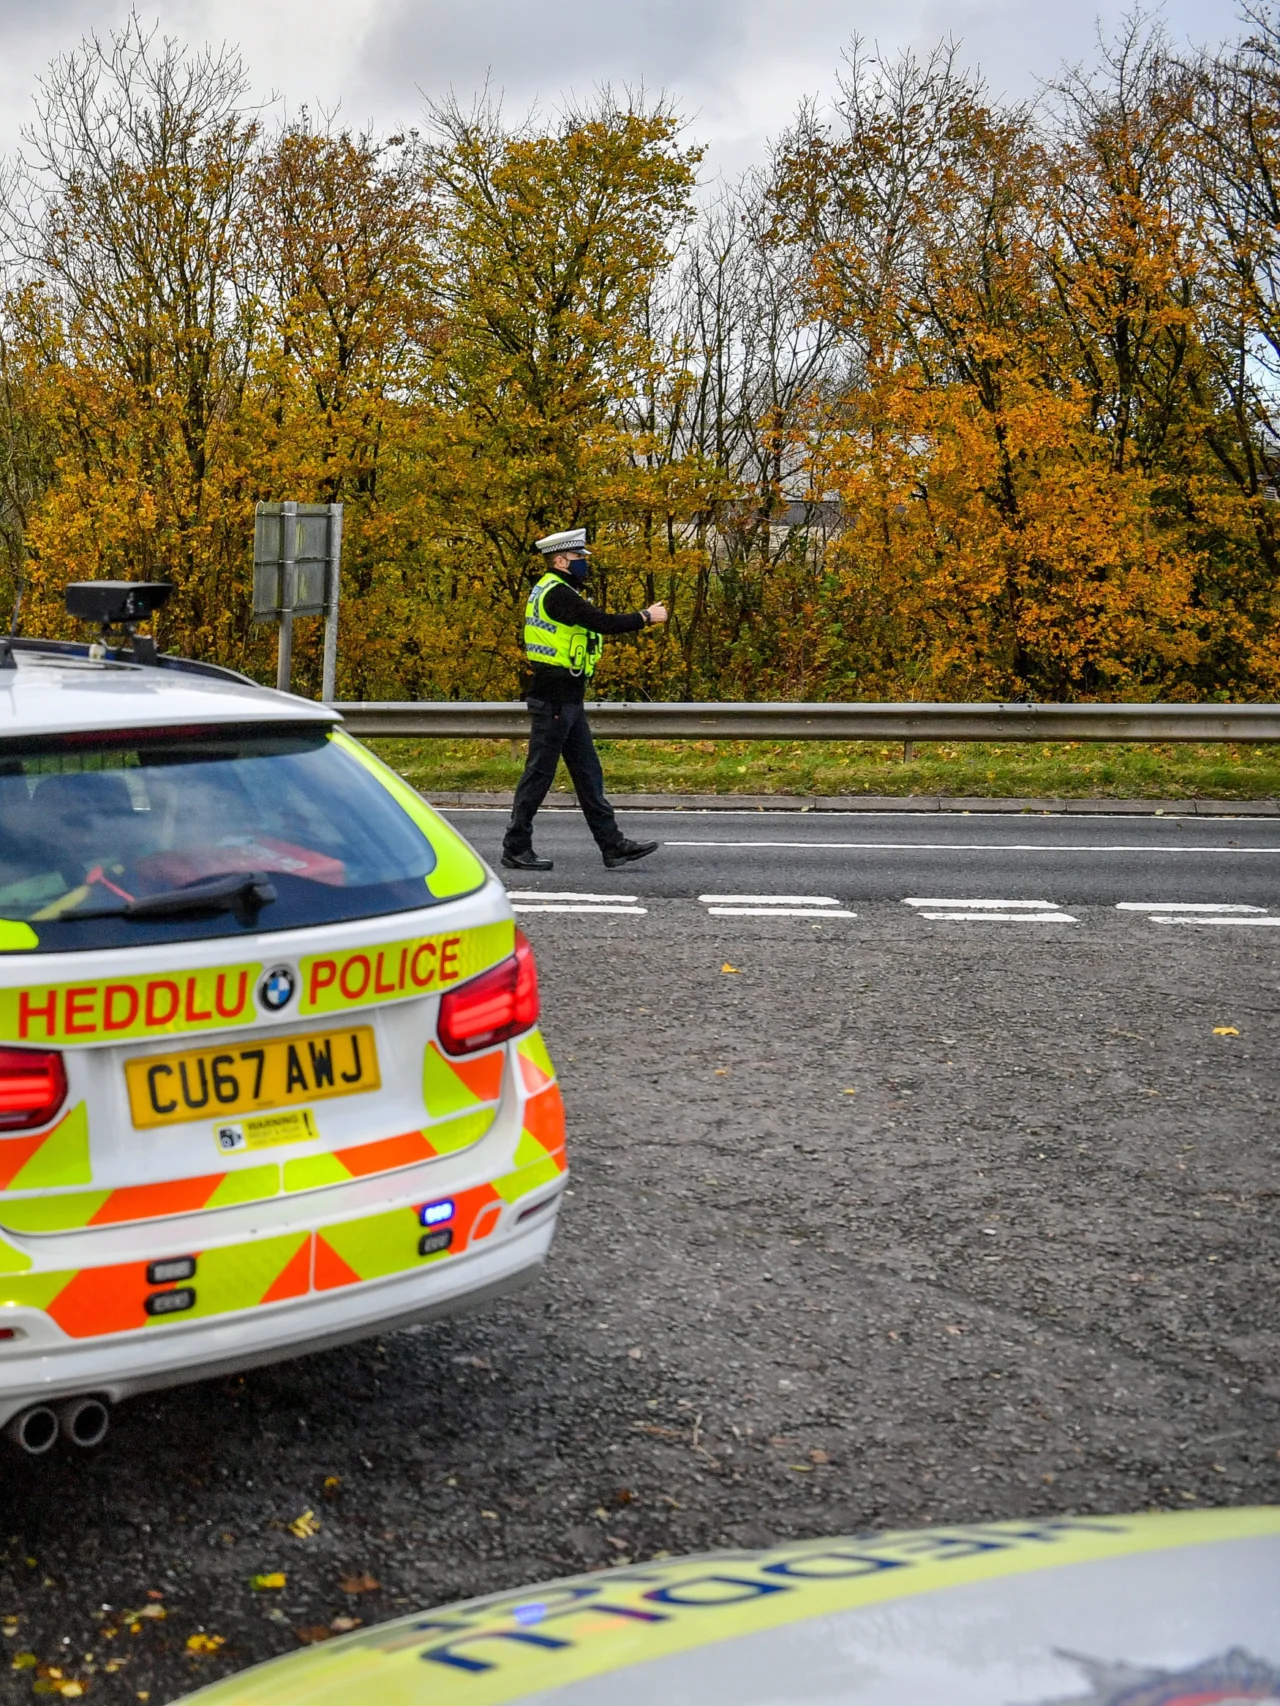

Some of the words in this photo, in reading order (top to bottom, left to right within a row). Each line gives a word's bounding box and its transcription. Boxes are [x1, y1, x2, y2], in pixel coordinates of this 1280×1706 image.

[19, 970, 248, 1039] HEDDLU
[309, 938, 460, 1005] POLICE
[147, 1049, 265, 1115] CU67
[285, 1034, 362, 1095] AWJ
[421, 1521, 1132, 1674] HEDDLU
